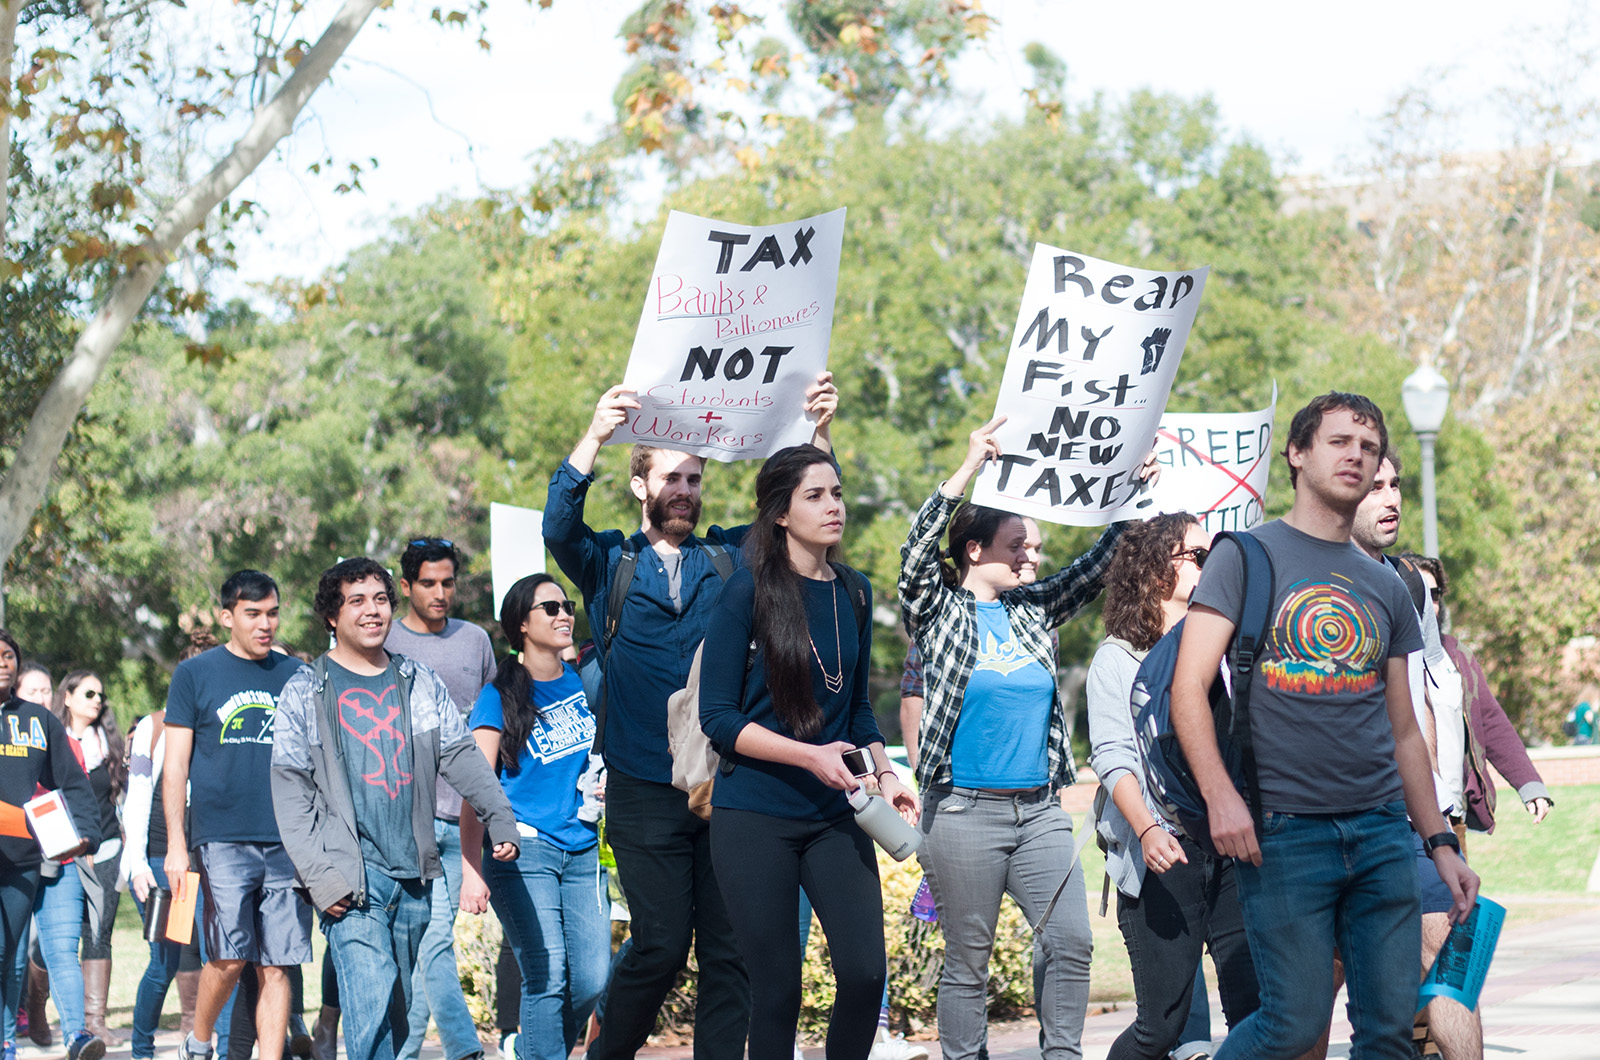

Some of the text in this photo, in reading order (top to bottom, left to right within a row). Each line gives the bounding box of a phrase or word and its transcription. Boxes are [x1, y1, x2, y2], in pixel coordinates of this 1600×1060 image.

[708, 226, 816, 274] TAX
[657, 274, 768, 316] Banks &
[715, 301, 820, 339] Billionaires
[680, 346, 795, 385] NOT
[647, 385, 774, 408] Students
[632, 415, 763, 447] Workers
[1047, 406, 1122, 441] NO
[1026, 432, 1124, 466] NEW
[1155, 422, 1271, 467] GREED
[552, 733, 582, 750] ADMIT
